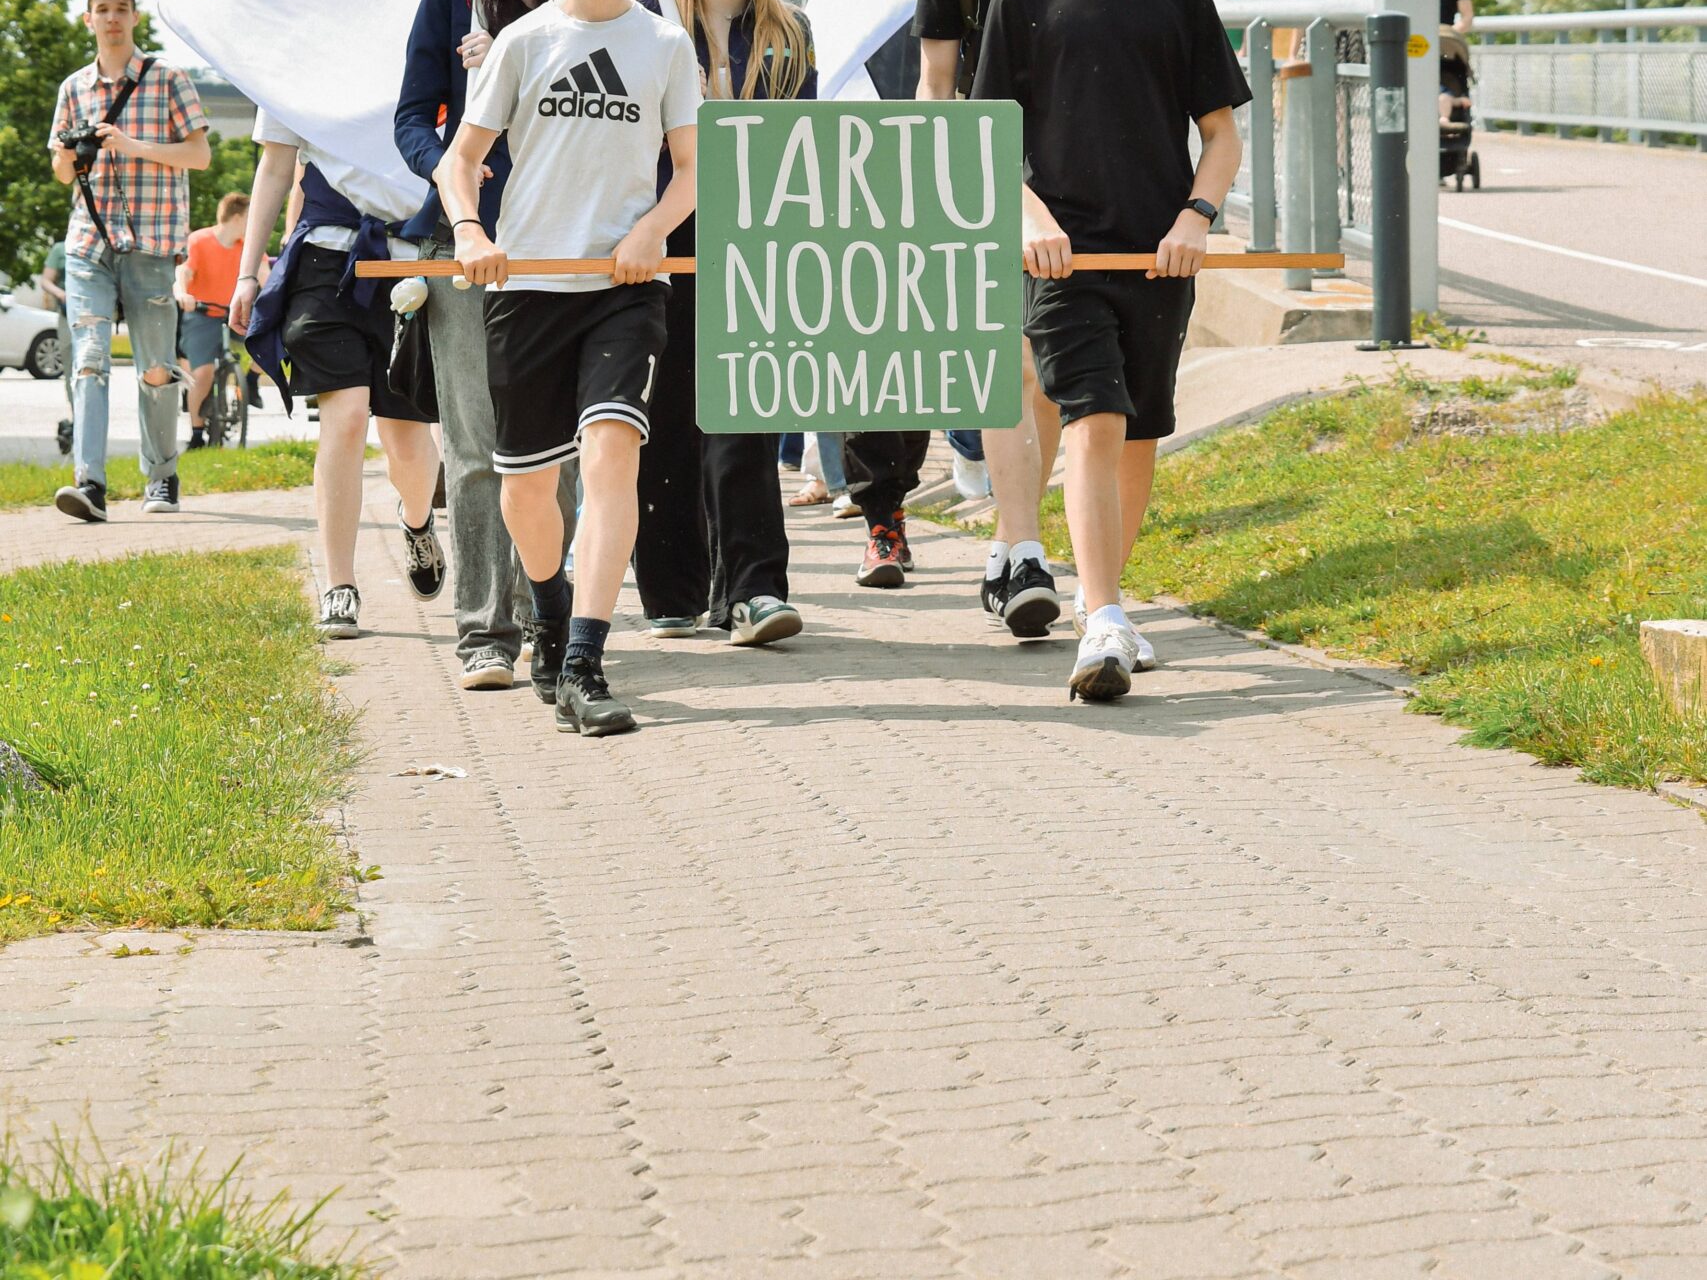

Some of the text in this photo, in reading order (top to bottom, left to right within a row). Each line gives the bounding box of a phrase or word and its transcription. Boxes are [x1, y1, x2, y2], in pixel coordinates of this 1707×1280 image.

[538, 91, 641, 123] adidas
[715, 115, 996, 230] TARTU
[726, 240, 1006, 336] NOORTE
[716, 340, 997, 418] TÖÖMALEV
